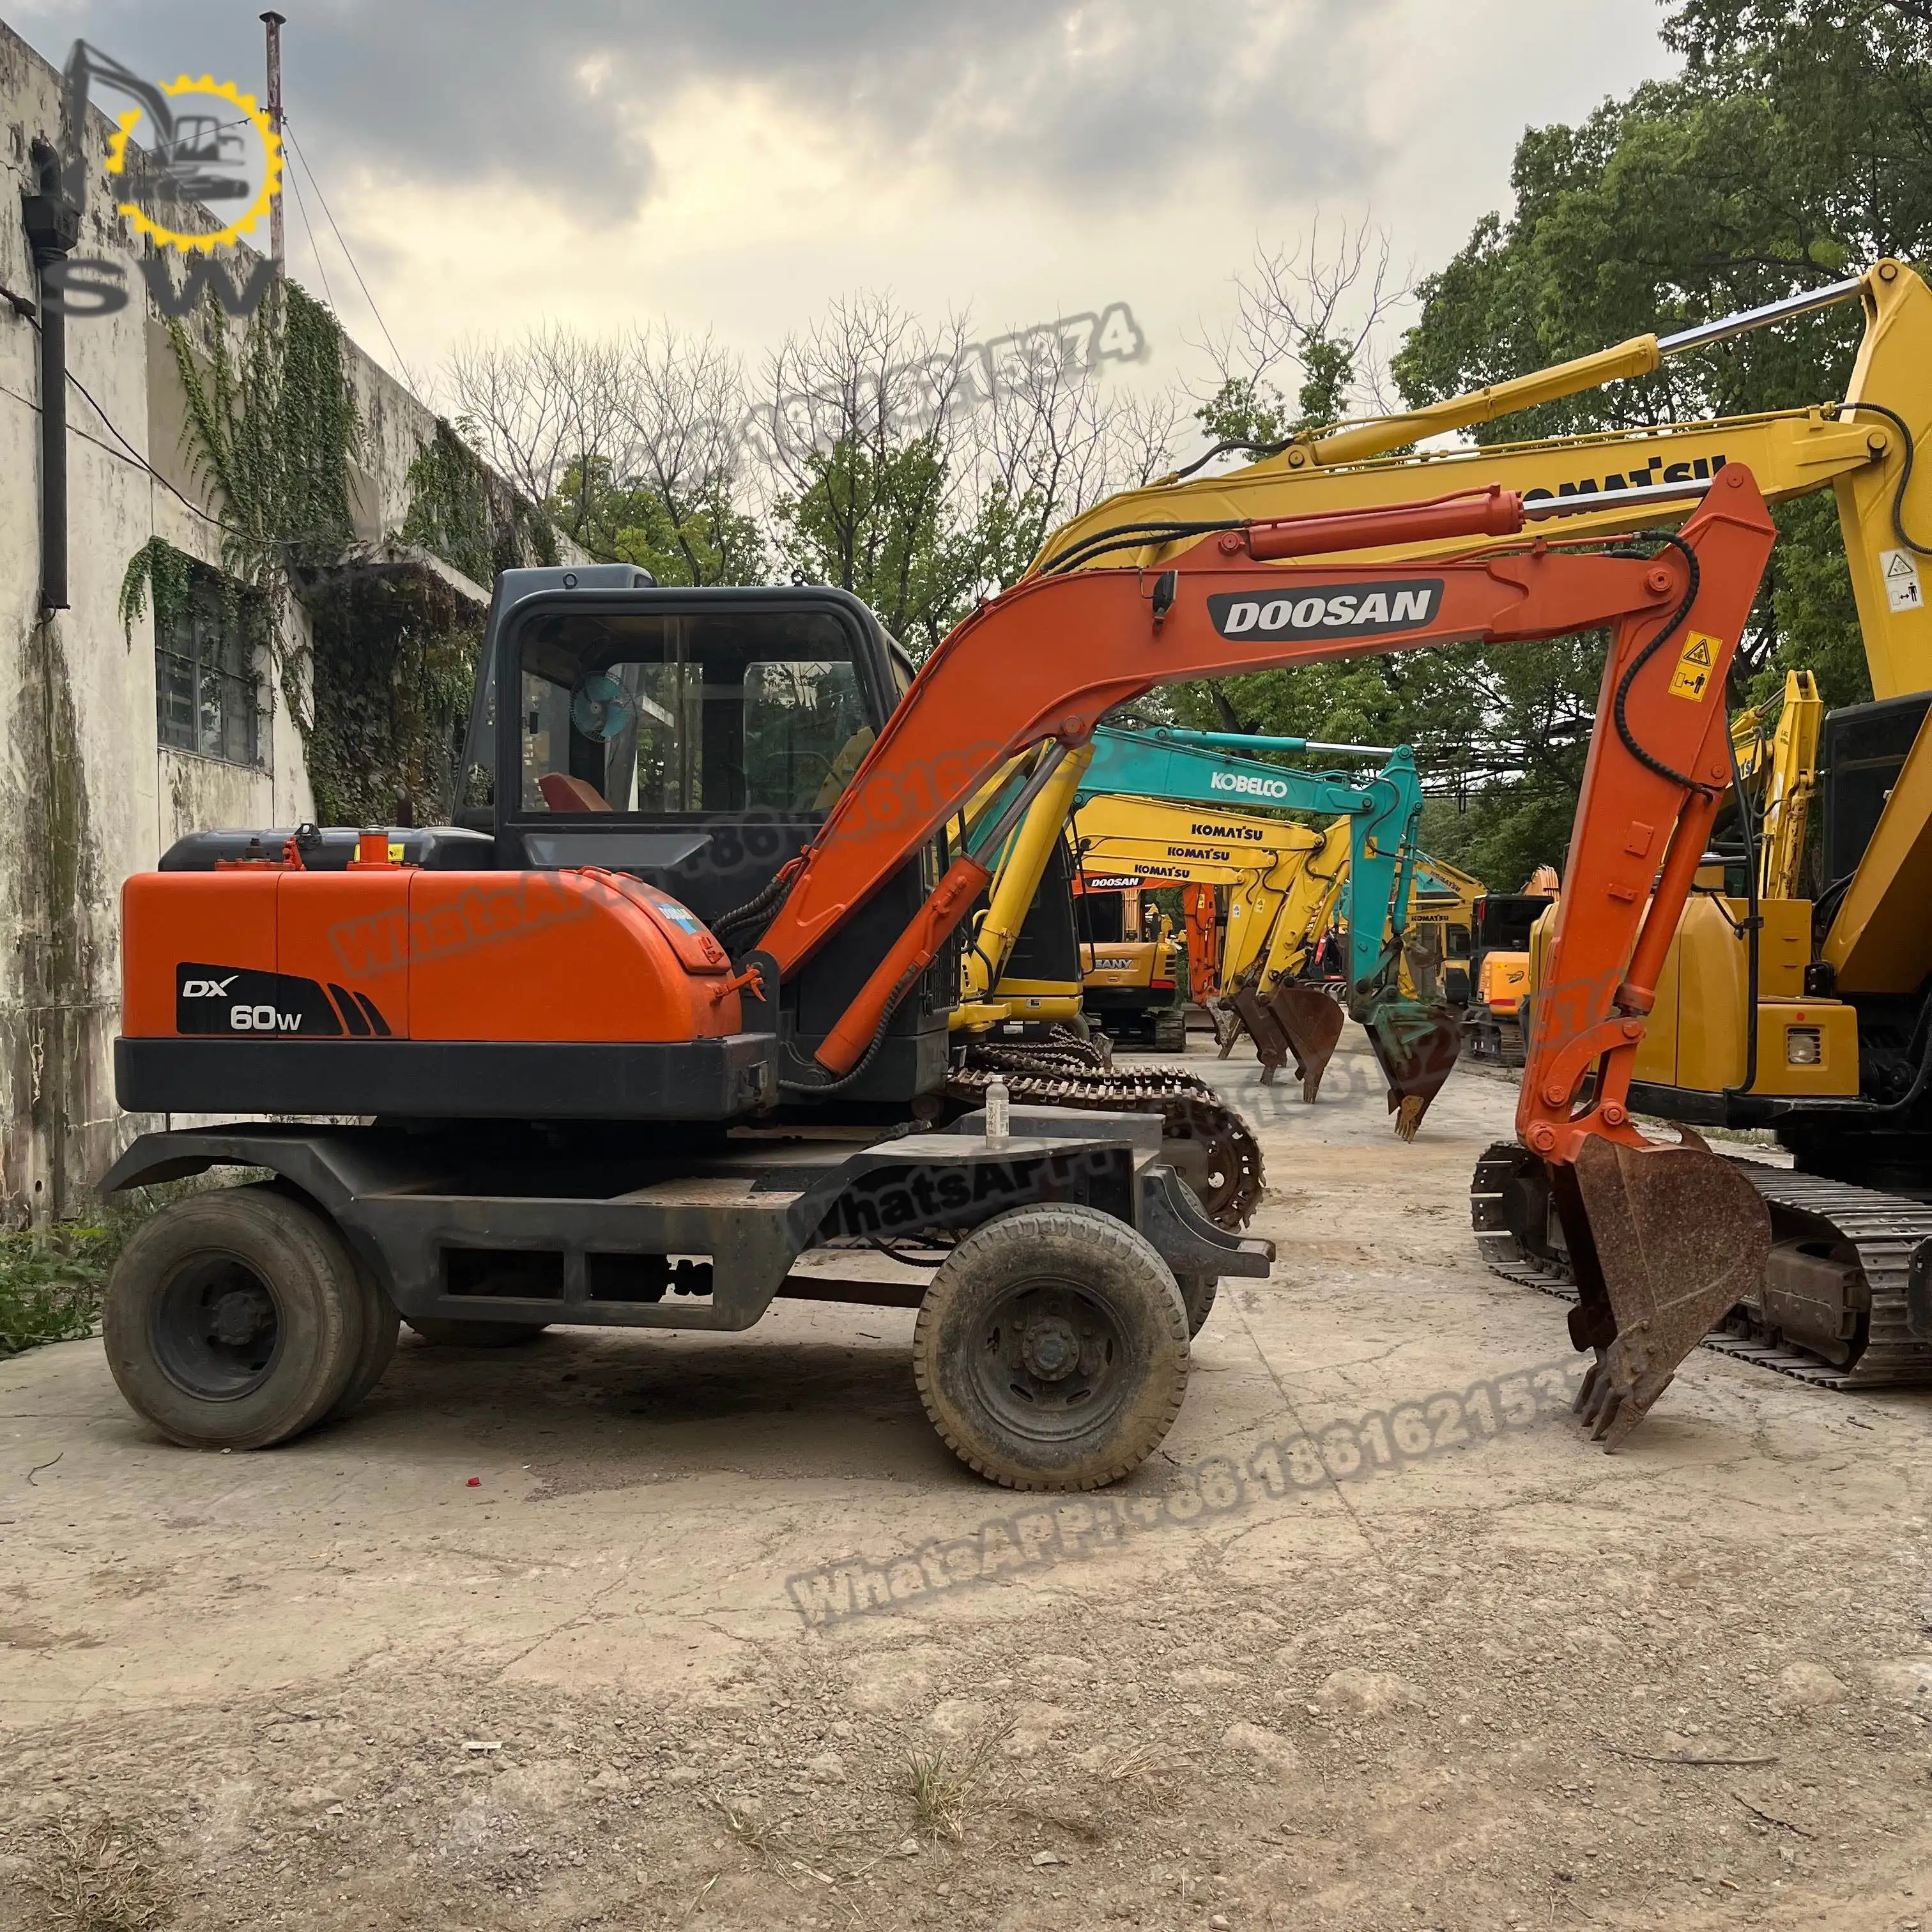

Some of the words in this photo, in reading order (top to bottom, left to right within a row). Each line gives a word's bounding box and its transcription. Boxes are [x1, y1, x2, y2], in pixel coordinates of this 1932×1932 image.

[1223, 590, 1432, 634] DOOSAN
[1211, 771, 1288, 799] KOBELCO
[1191, 824, 1264, 841] KOMATSU
[1167, 846, 1230, 861] KOMATSU
[1134, 864, 1190, 879] KOMATSU
[1091, 877, 1139, 887] DOOSAN
[1411, 914, 1449, 922] KOMATSU
[183, 975, 240, 997] DX
